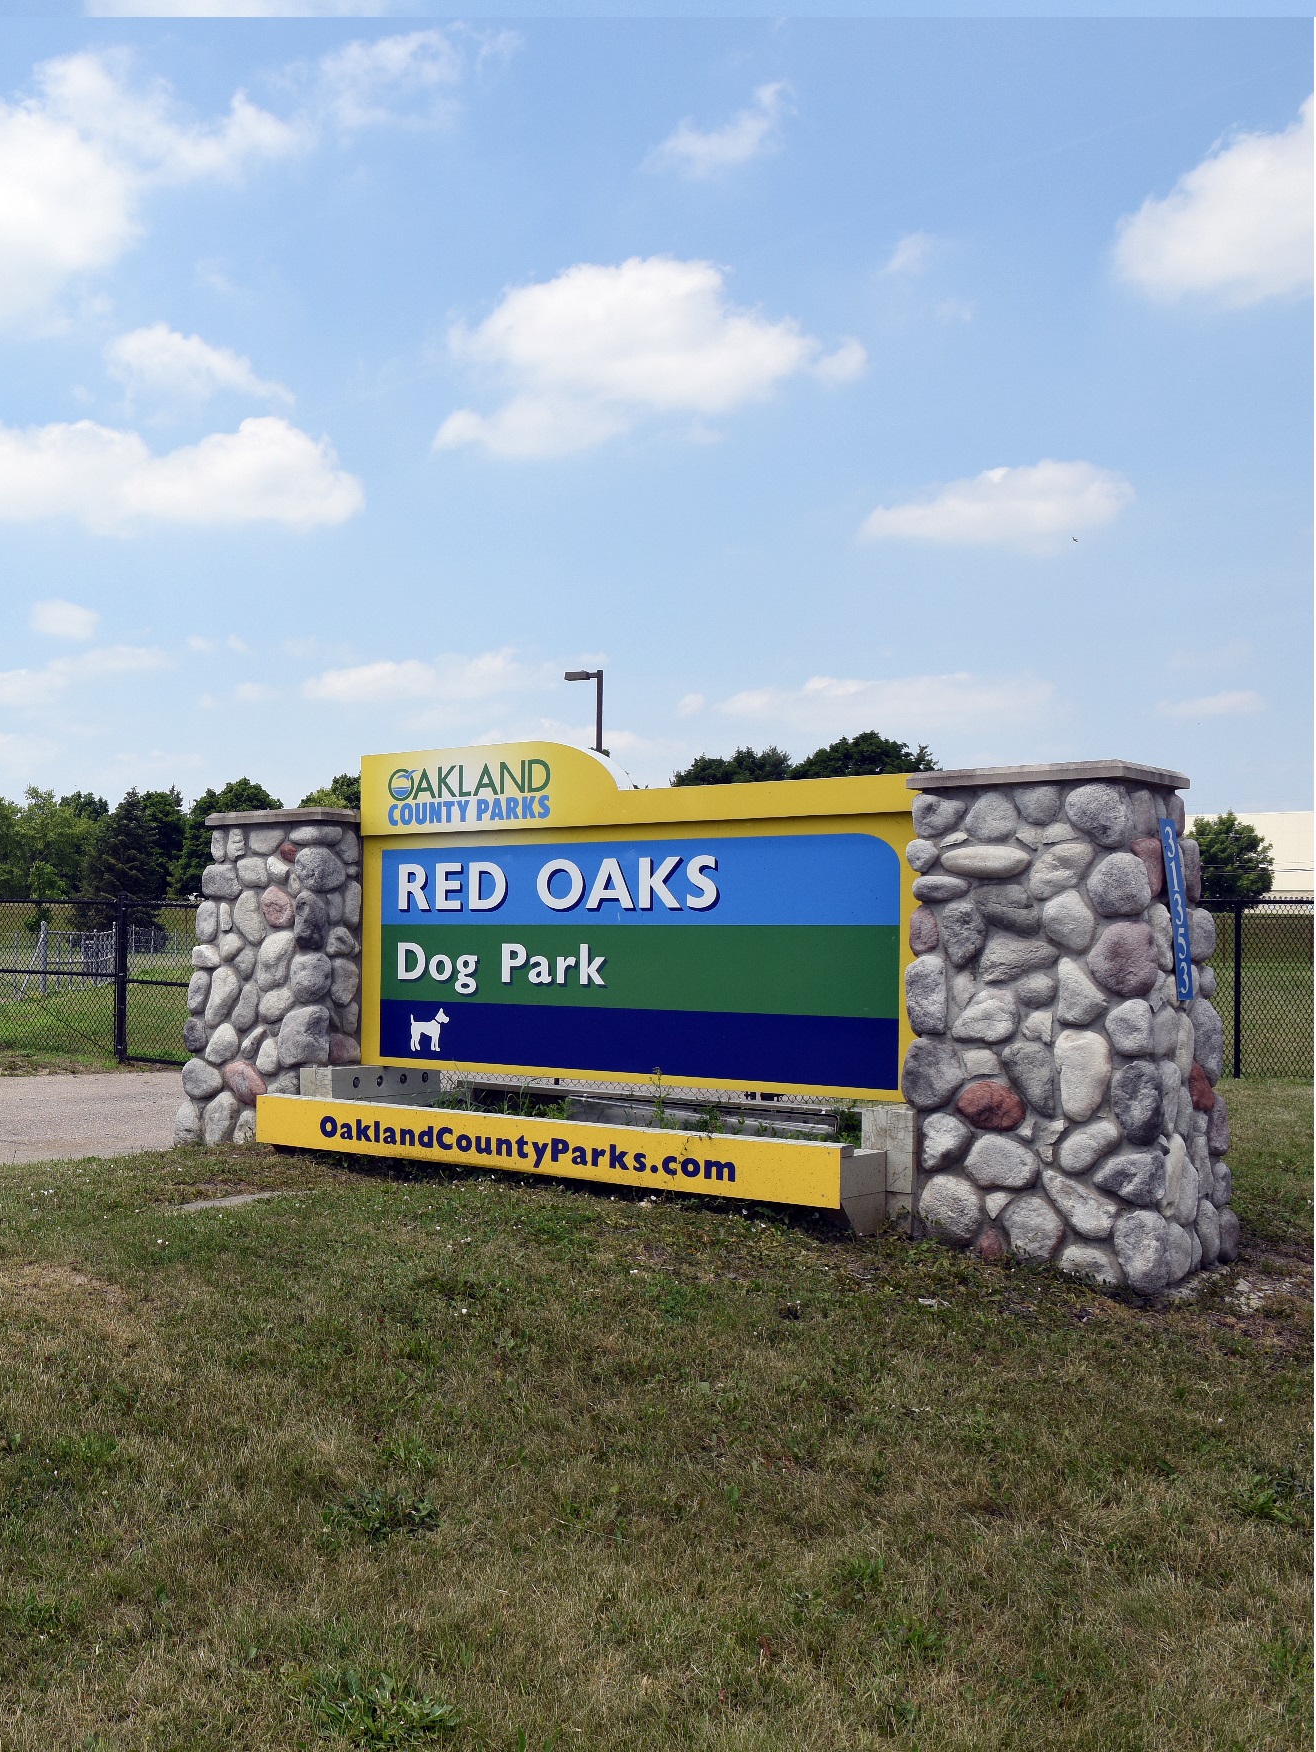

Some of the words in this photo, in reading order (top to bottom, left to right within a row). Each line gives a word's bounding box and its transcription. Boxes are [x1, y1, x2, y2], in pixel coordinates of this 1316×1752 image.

[387, 758, 551, 802] OAKLAND
[387, 799, 471, 827] COUNTY
[476, 794, 551, 822] PARKS
[397, 861, 508, 912] RED
[536, 854, 721, 912] OAKS
[1164, 825, 1190, 994] 31353
[396, 941, 479, 995] Dog
[500, 942, 608, 987] Park
[319, 1114, 737, 1183] OaklandCountyParks.com
